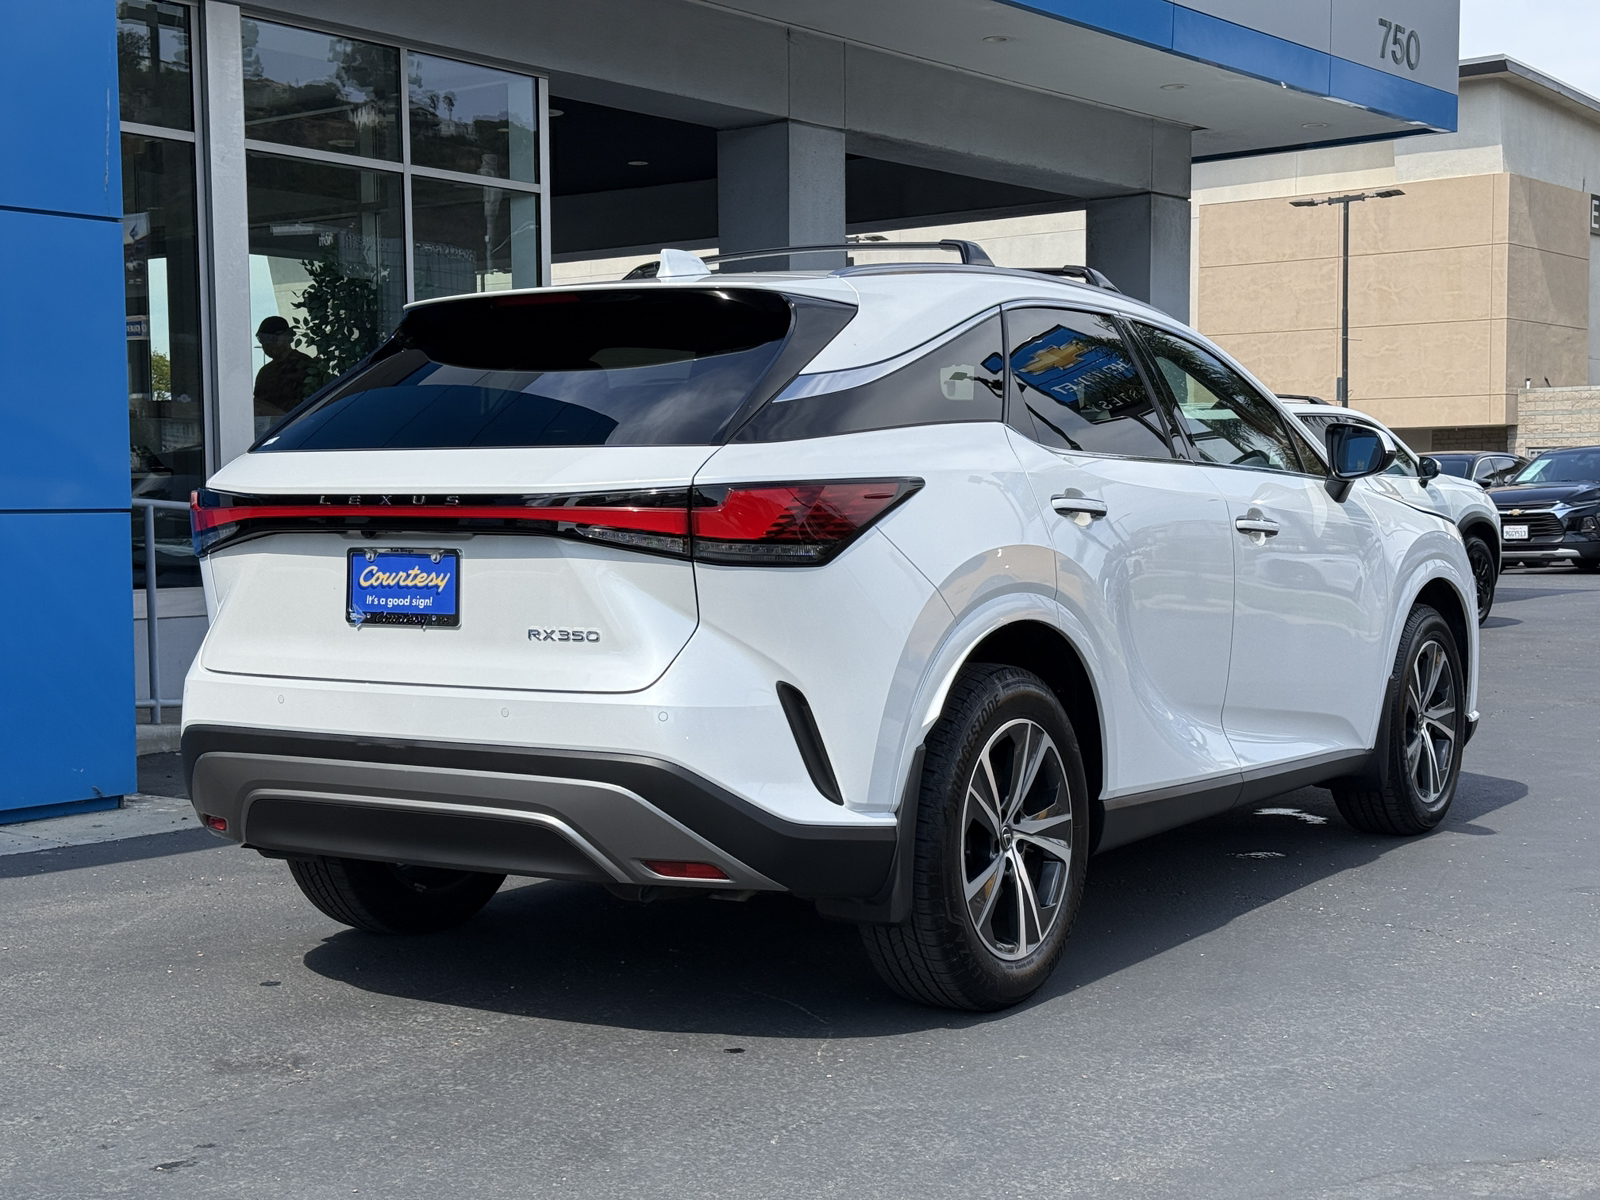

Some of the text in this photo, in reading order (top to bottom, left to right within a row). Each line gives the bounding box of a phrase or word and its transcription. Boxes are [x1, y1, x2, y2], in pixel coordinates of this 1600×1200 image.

[1378, 18, 1421, 71] 750
[319, 495, 460, 506] LEXUS
[359, 565, 451, 593] Courtesy
[366, 594, 433, 609] It's a good sign!
[528, 628, 601, 642] RX350
